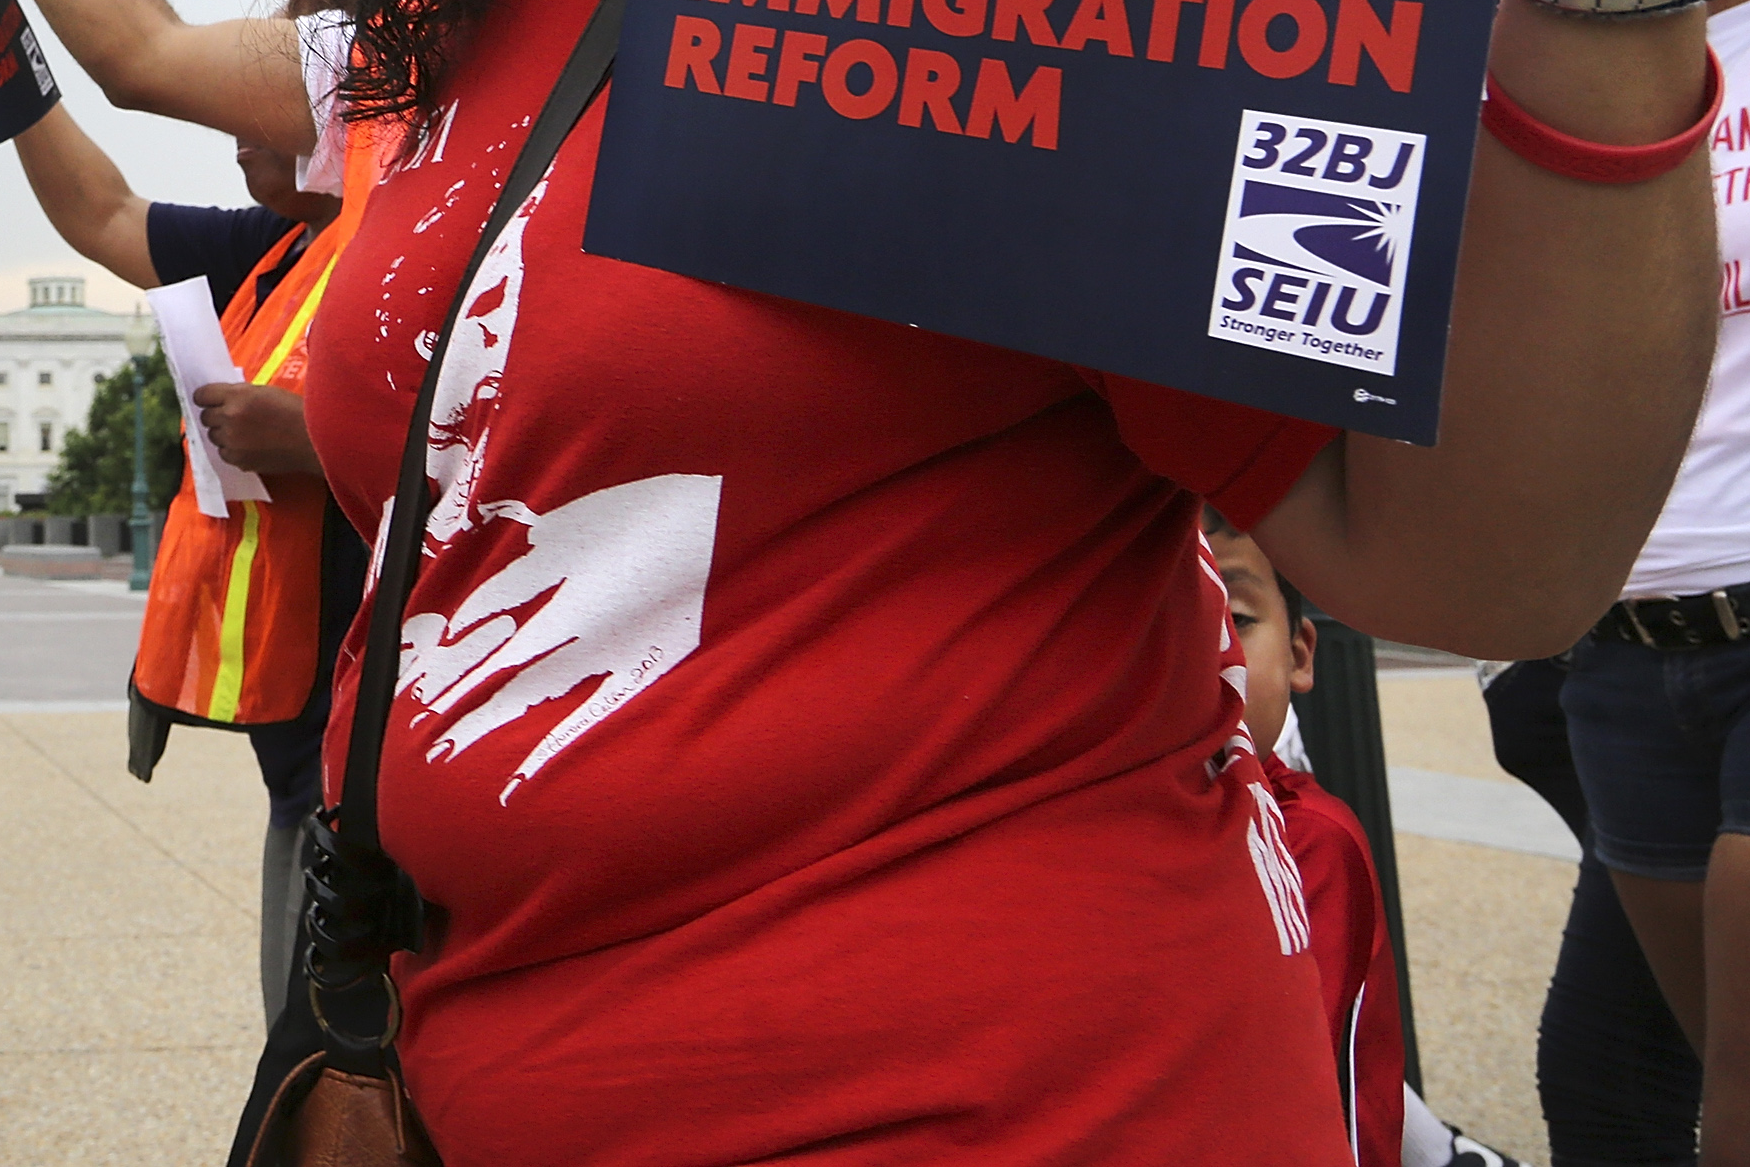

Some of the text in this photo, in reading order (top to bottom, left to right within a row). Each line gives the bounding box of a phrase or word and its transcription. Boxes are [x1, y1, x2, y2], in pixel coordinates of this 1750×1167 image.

[662, 16, 1064, 151] REFORM
[1241, 121, 1416, 190] 32BJ
[1221, 266, 1392, 336] SEIU
[1219, 315, 1384, 362] Stronger Together
